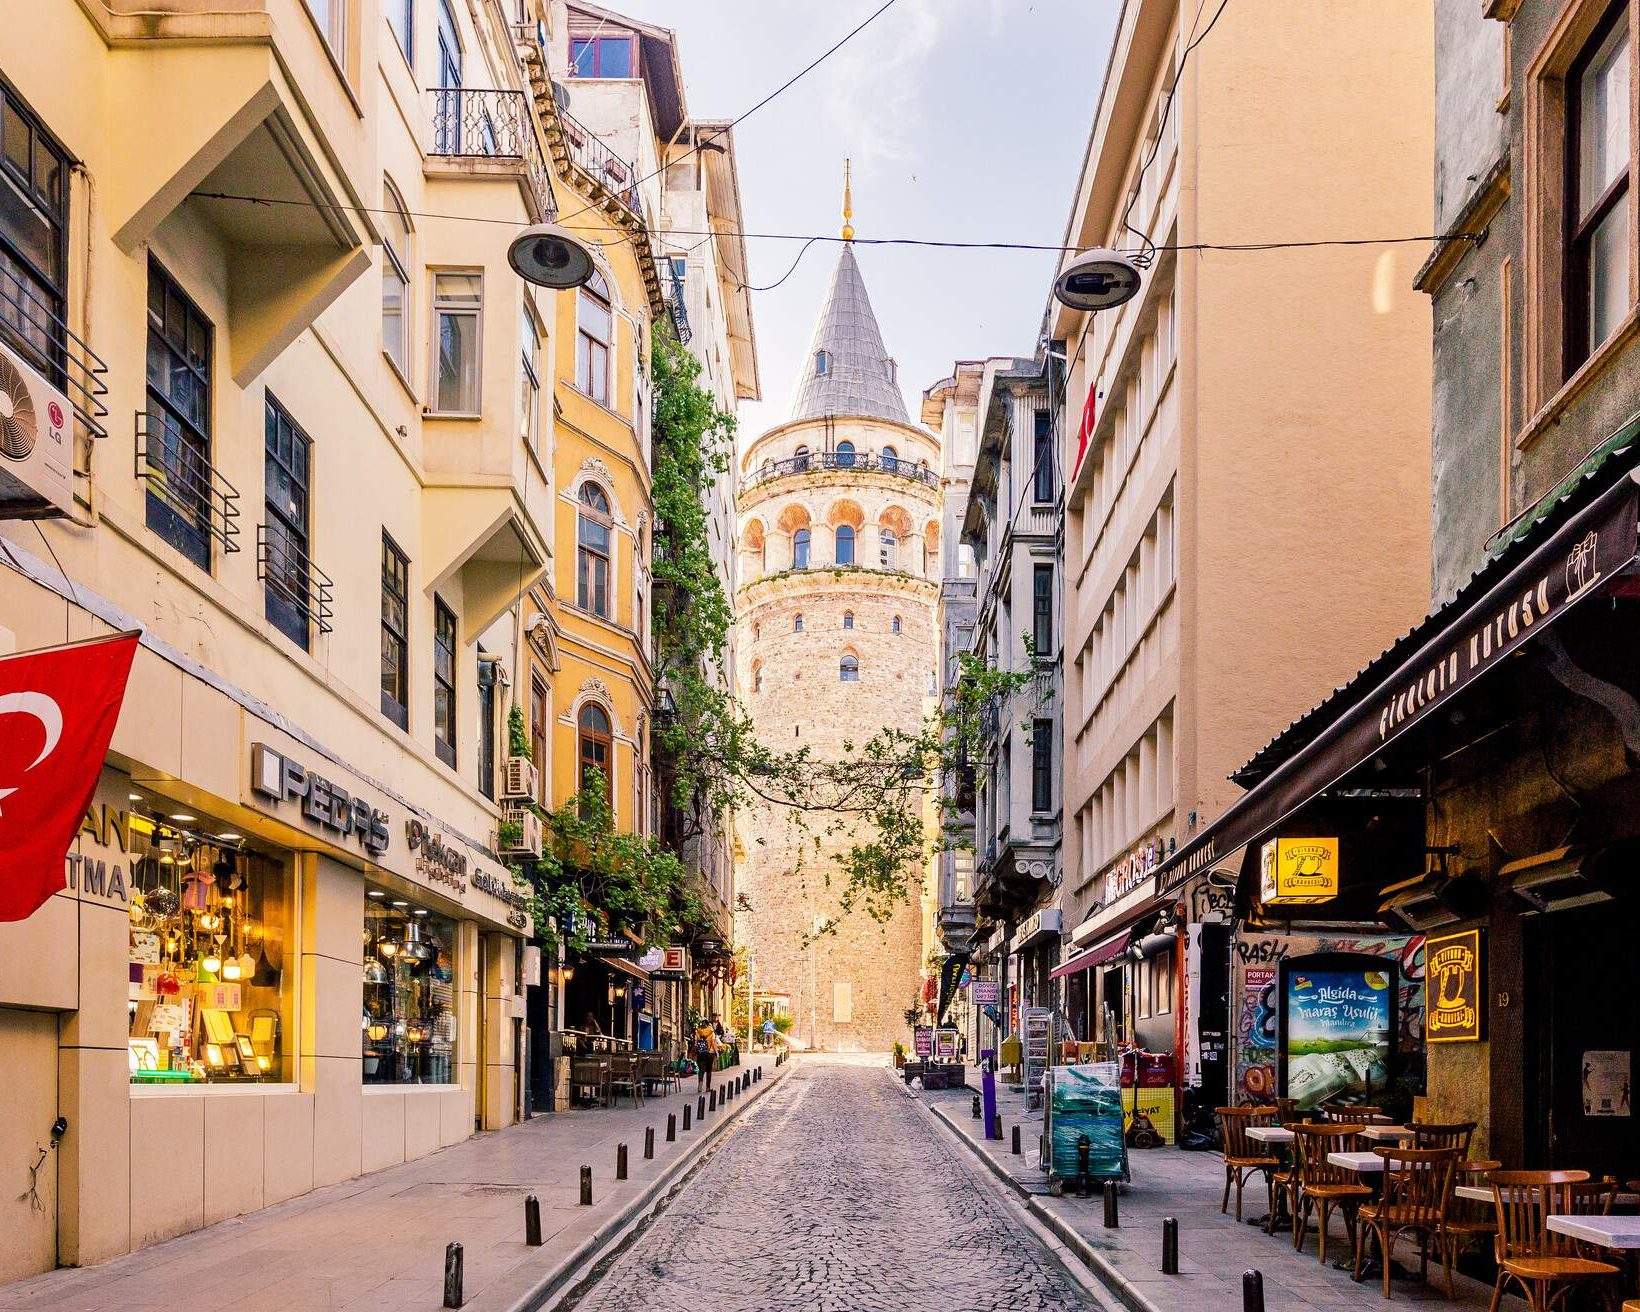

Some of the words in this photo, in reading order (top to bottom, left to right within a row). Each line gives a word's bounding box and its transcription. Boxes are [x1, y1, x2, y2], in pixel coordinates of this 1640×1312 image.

[1470, 576, 1550, 669] KUTUSU
[82, 804, 129, 853] AN
[65, 852, 127, 902] TMA
[666, 952, 679, 966] E
[1247, 971, 1275, 979] PORTAK
[1318, 986, 1357, 1003] Algida
